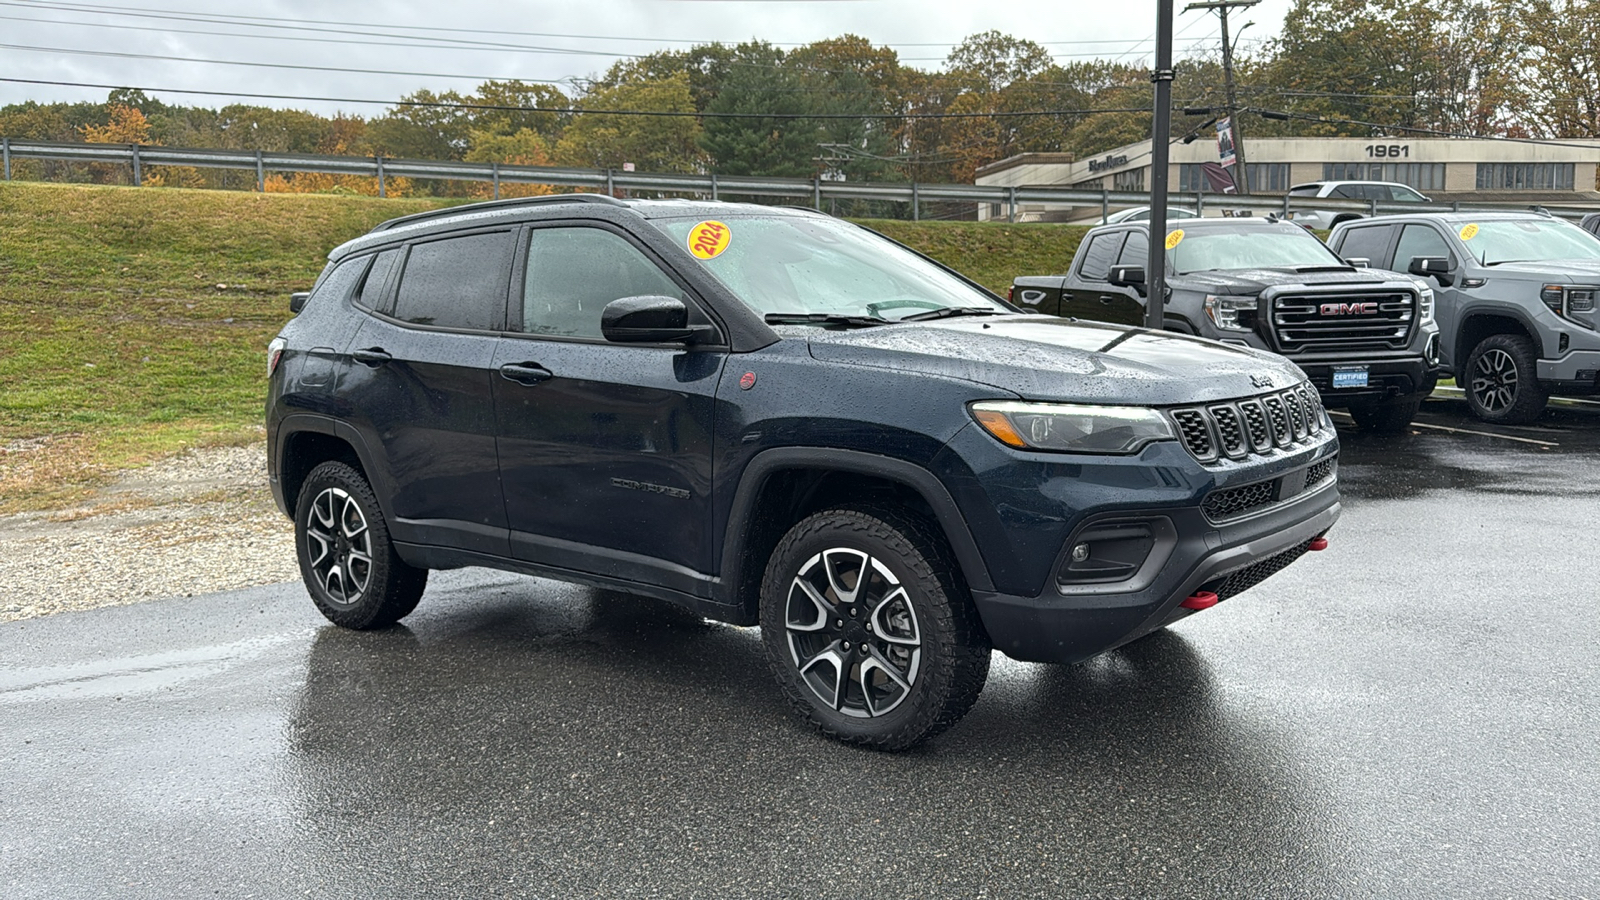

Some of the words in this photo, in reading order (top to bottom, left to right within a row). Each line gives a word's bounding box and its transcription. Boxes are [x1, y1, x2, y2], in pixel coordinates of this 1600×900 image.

[1365, 145, 1409, 157] 1961
[694, 222, 725, 255] 2024
[1320, 303, 1378, 316] GMC
[1334, 373, 1368, 381] CERTIFIED
